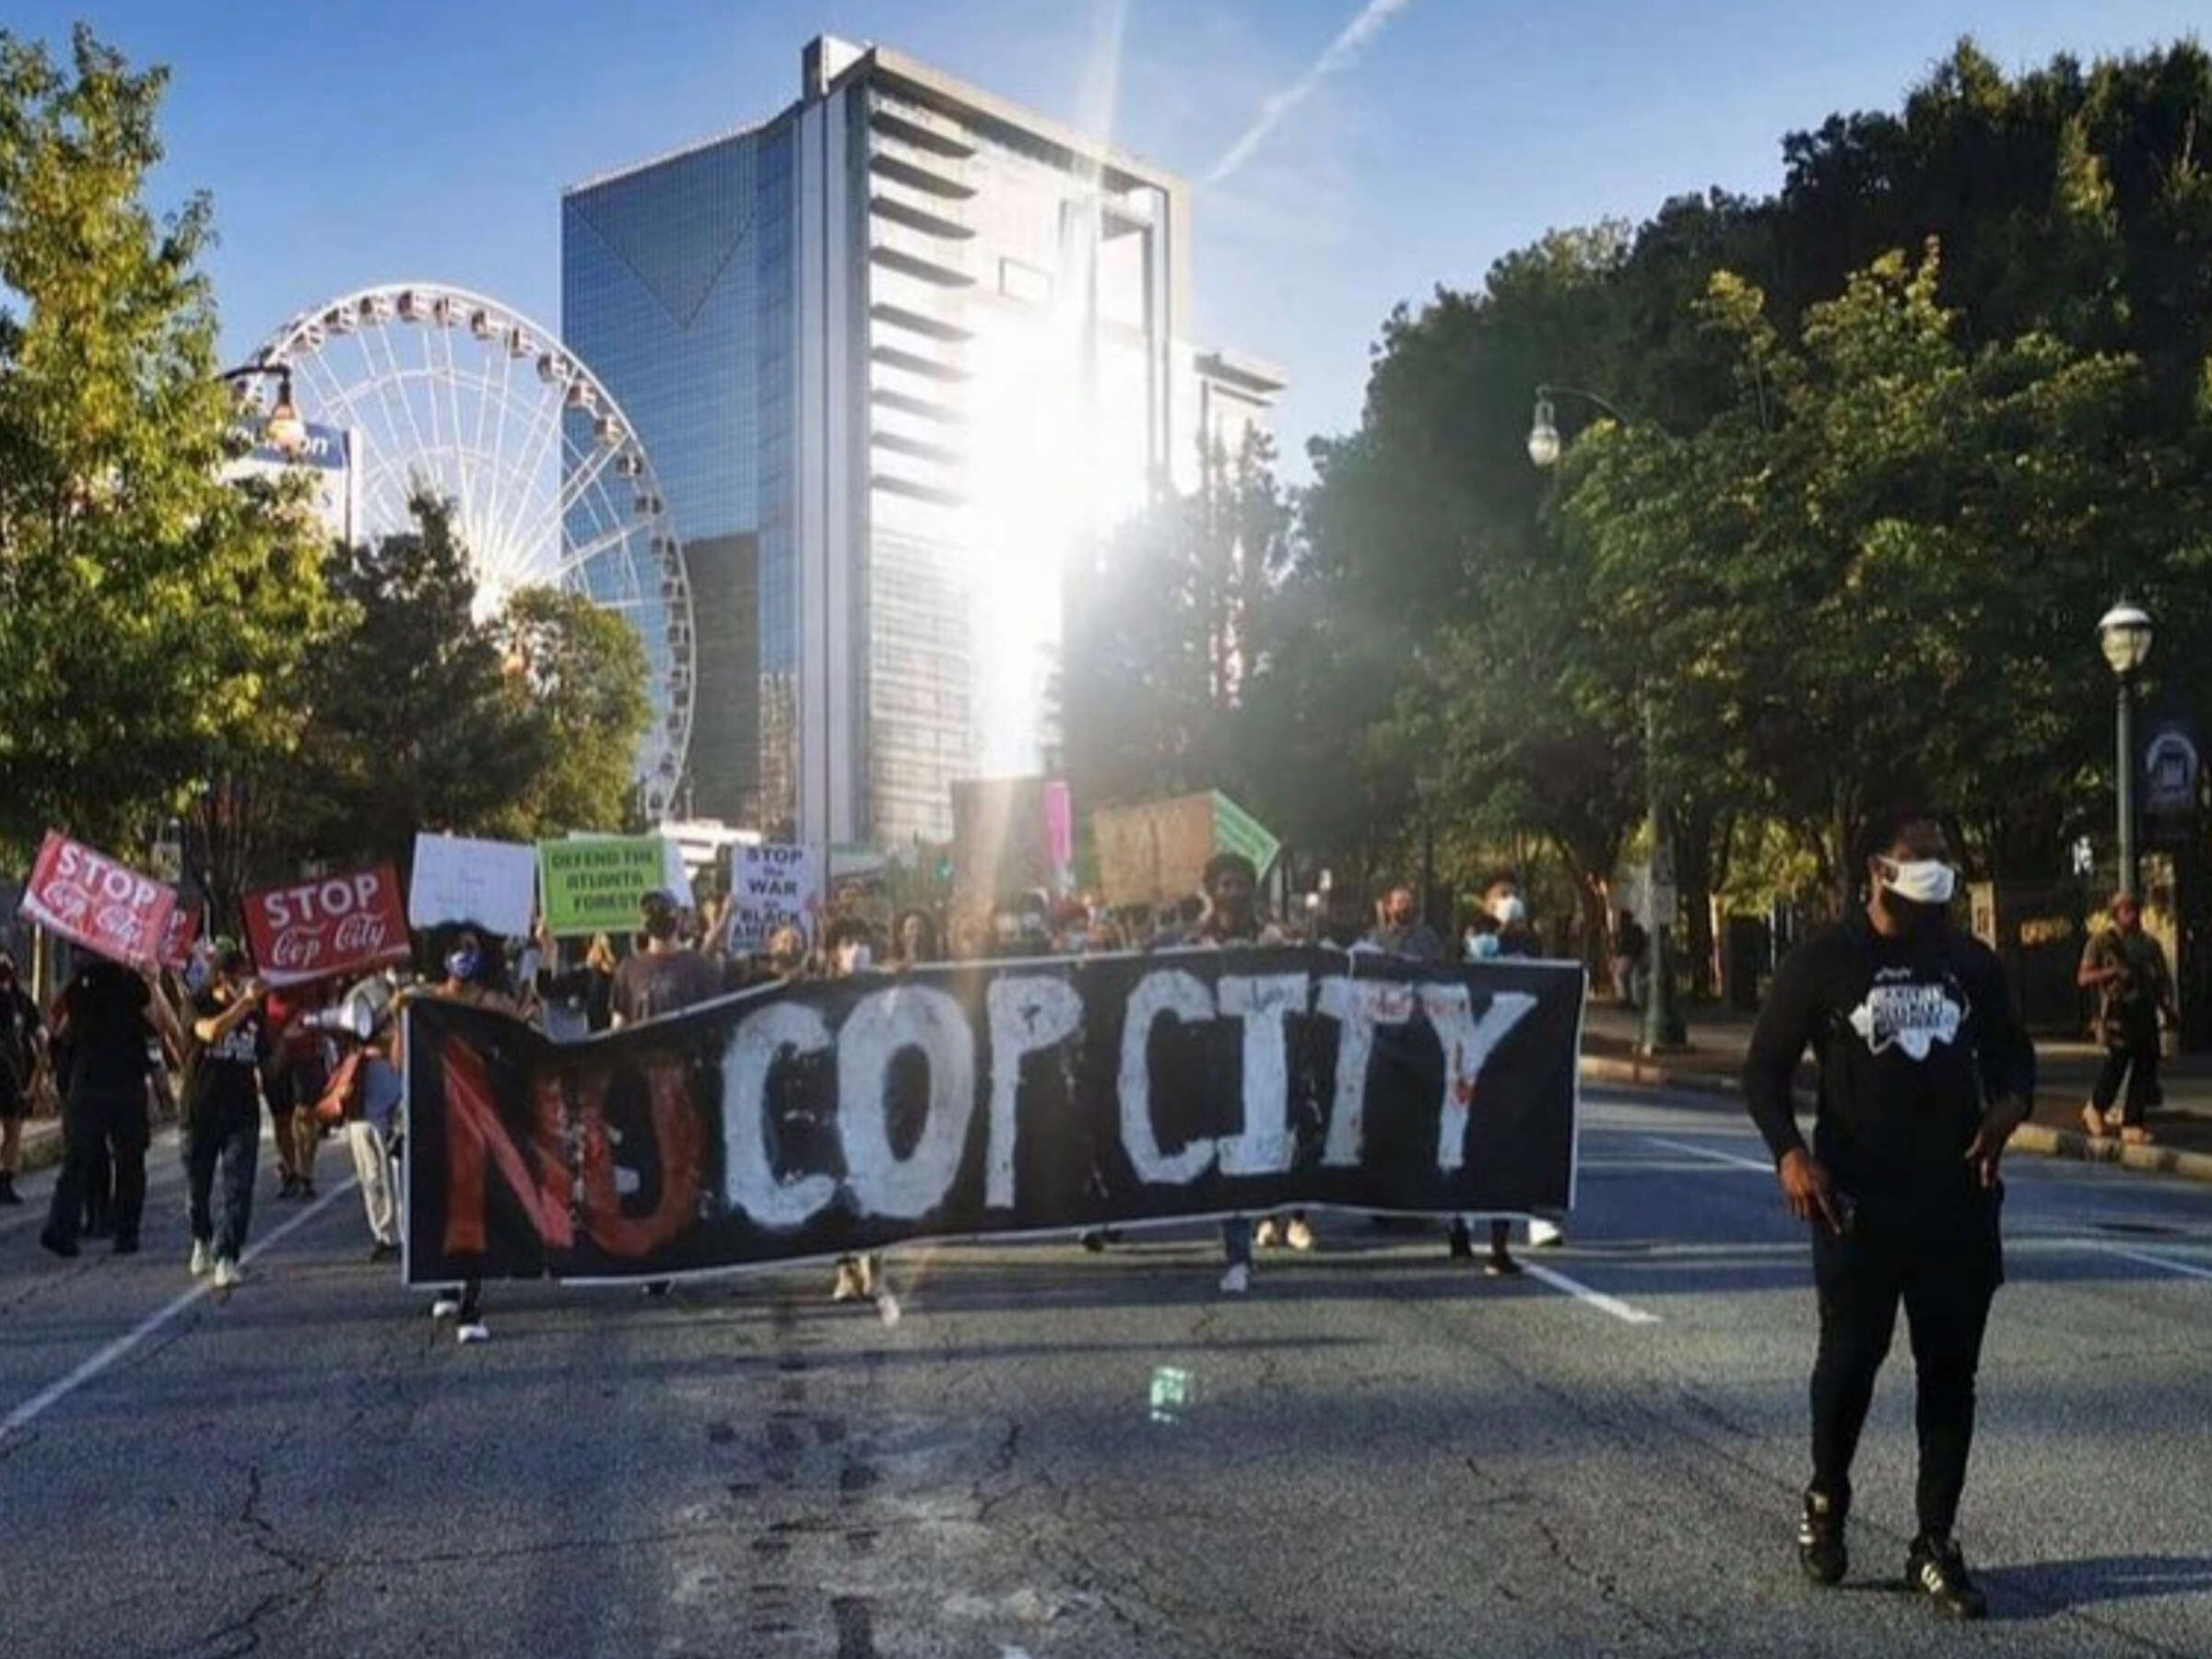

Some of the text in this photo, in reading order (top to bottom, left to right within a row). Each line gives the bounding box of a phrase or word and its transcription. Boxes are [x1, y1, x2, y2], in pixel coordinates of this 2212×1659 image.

[57, 842, 157, 906] STOP
[551, 850, 619, 867] DEFEND
[745, 846, 804, 865] STOP
[566, 869, 643, 890] ATLANTA
[747, 878, 798, 898] WAR
[265, 873, 379, 930] STOP
[272, 910, 389, 968] Cop City
[443, 968, 1538, 1259] NO COP CITY
